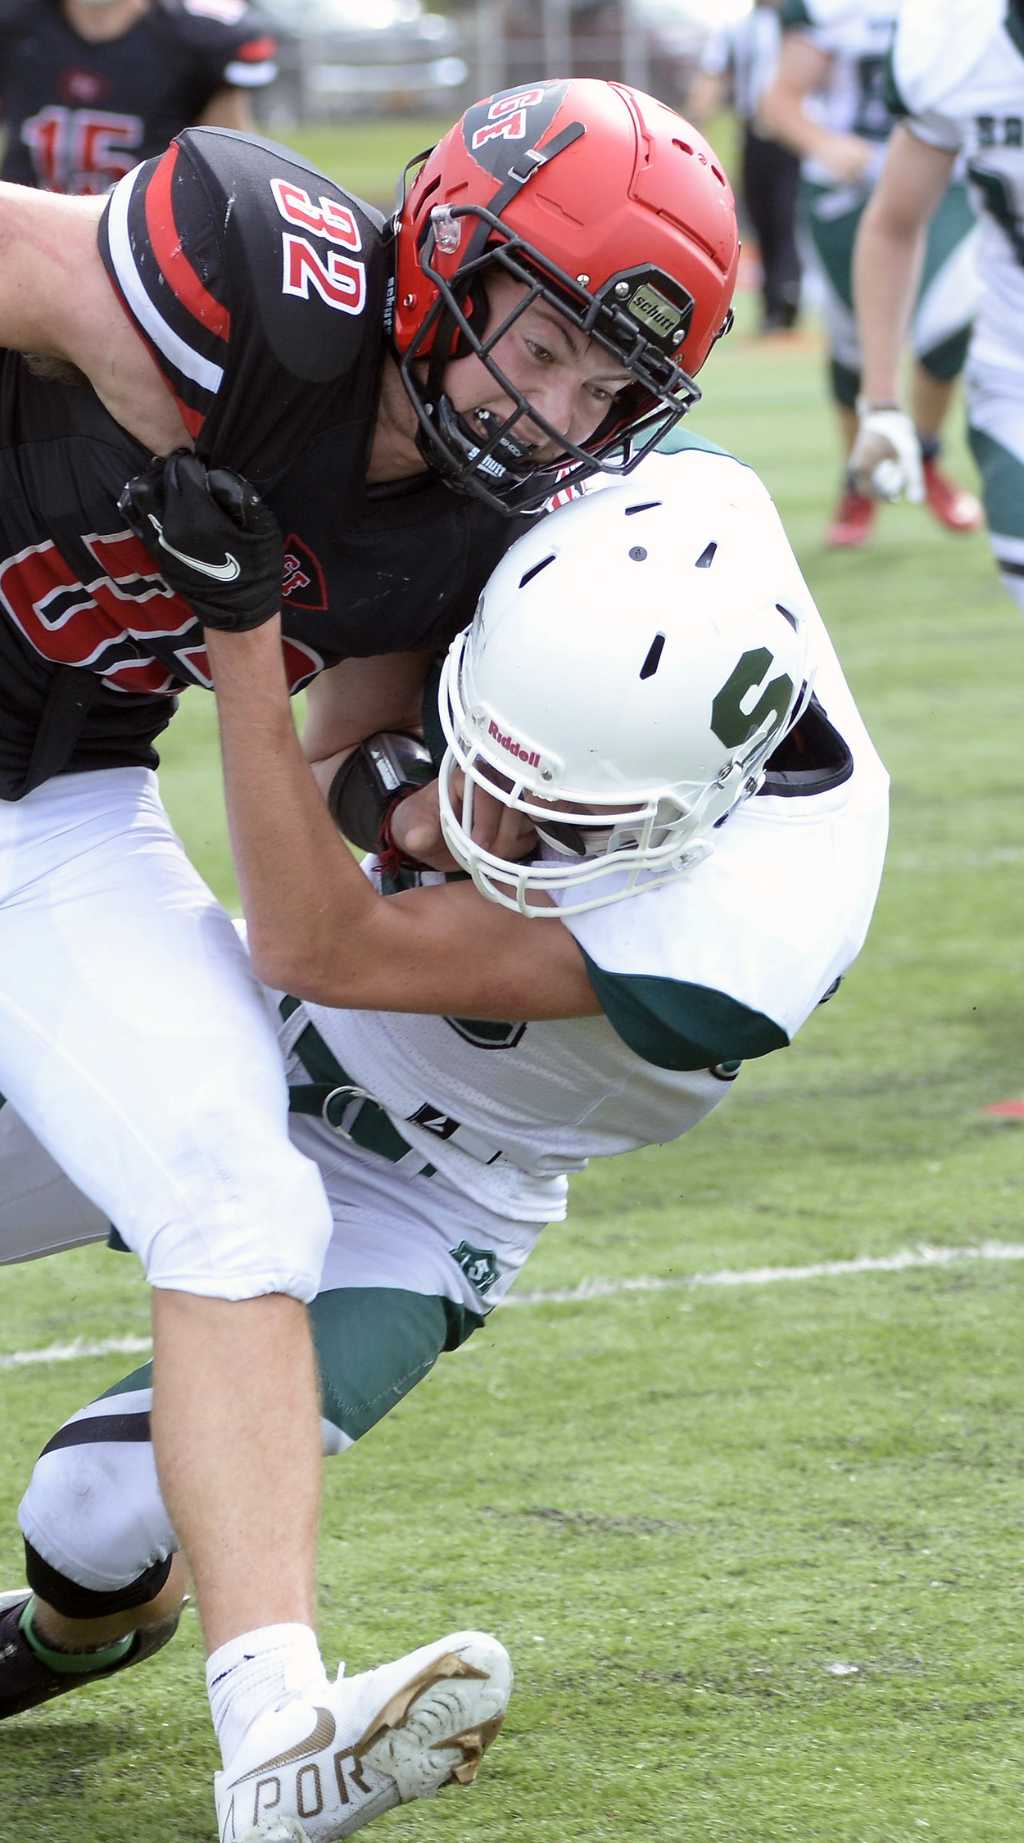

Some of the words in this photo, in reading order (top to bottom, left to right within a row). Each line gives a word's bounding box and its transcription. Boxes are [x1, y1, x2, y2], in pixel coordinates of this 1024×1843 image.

[270, 178, 367, 316] 32
[633, 296, 675, 330] schutt
[710, 646, 794, 750] S
[487, 719, 541, 769] Riddell
